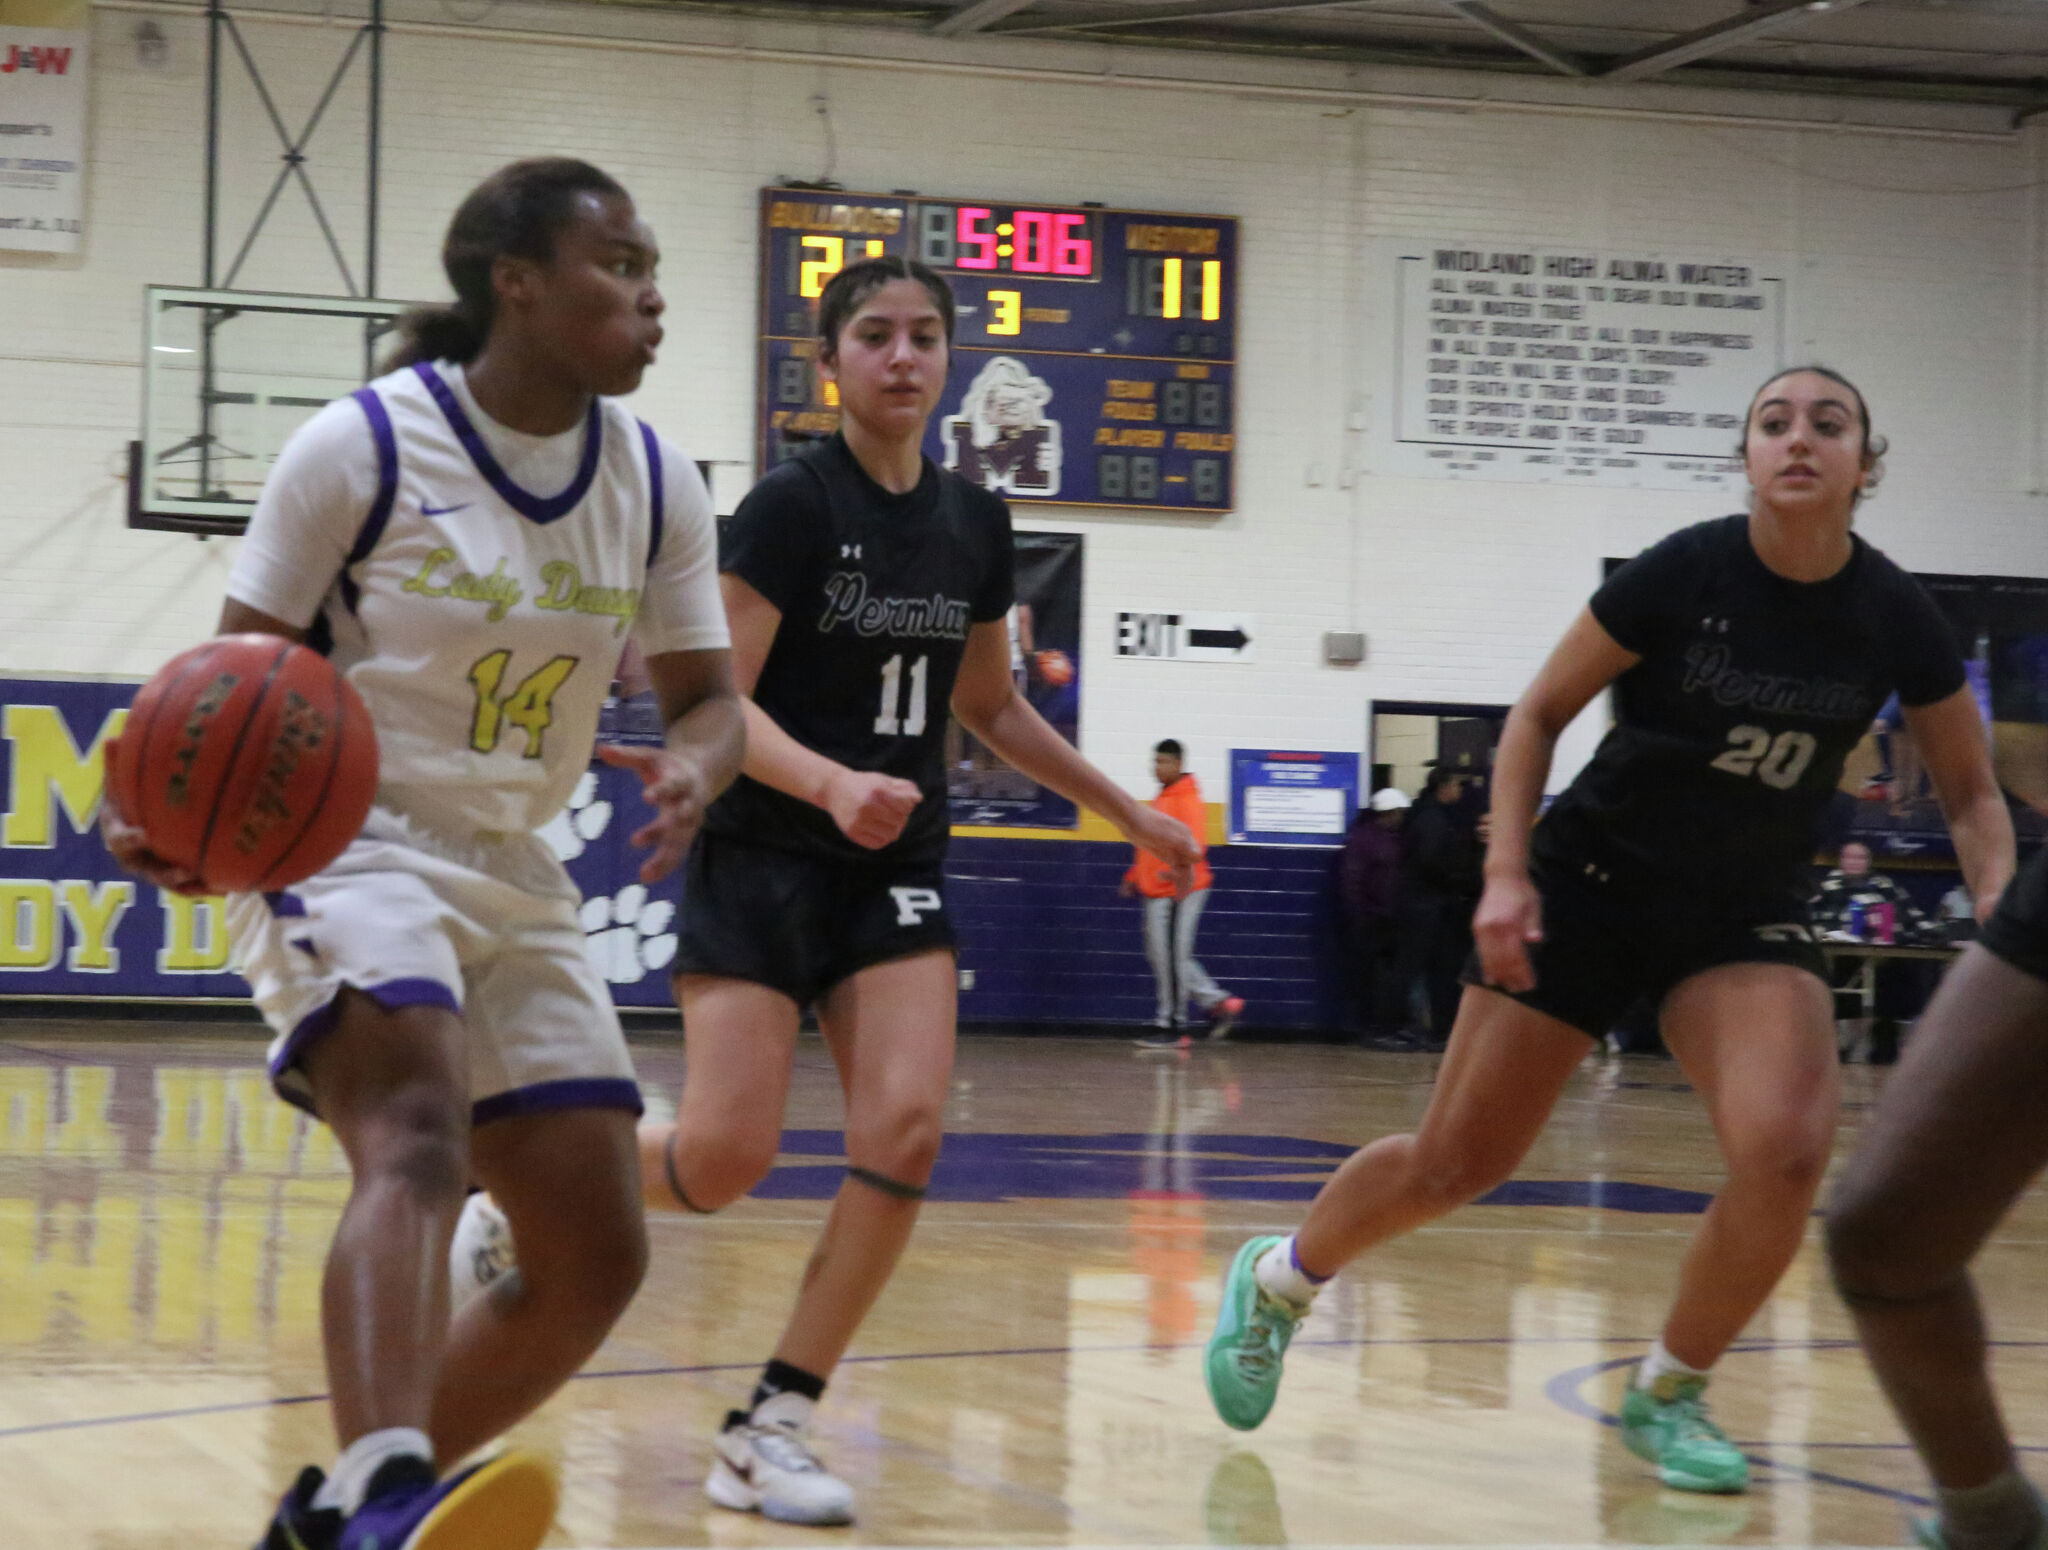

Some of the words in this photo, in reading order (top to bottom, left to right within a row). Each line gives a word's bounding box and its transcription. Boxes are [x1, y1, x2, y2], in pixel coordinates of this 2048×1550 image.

[801, 236, 884, 297] 2
[956, 207, 1092, 275] 5:06
[987, 290, 1021, 335] 3
[1163, 258, 1220, 321] 11
[1115, 612, 1181, 657] EXIT
[467, 649, 579, 759] 14
[874, 654, 928, 736] 11
[1710, 725, 1816, 790] 20
[889, 885, 942, 926] P
